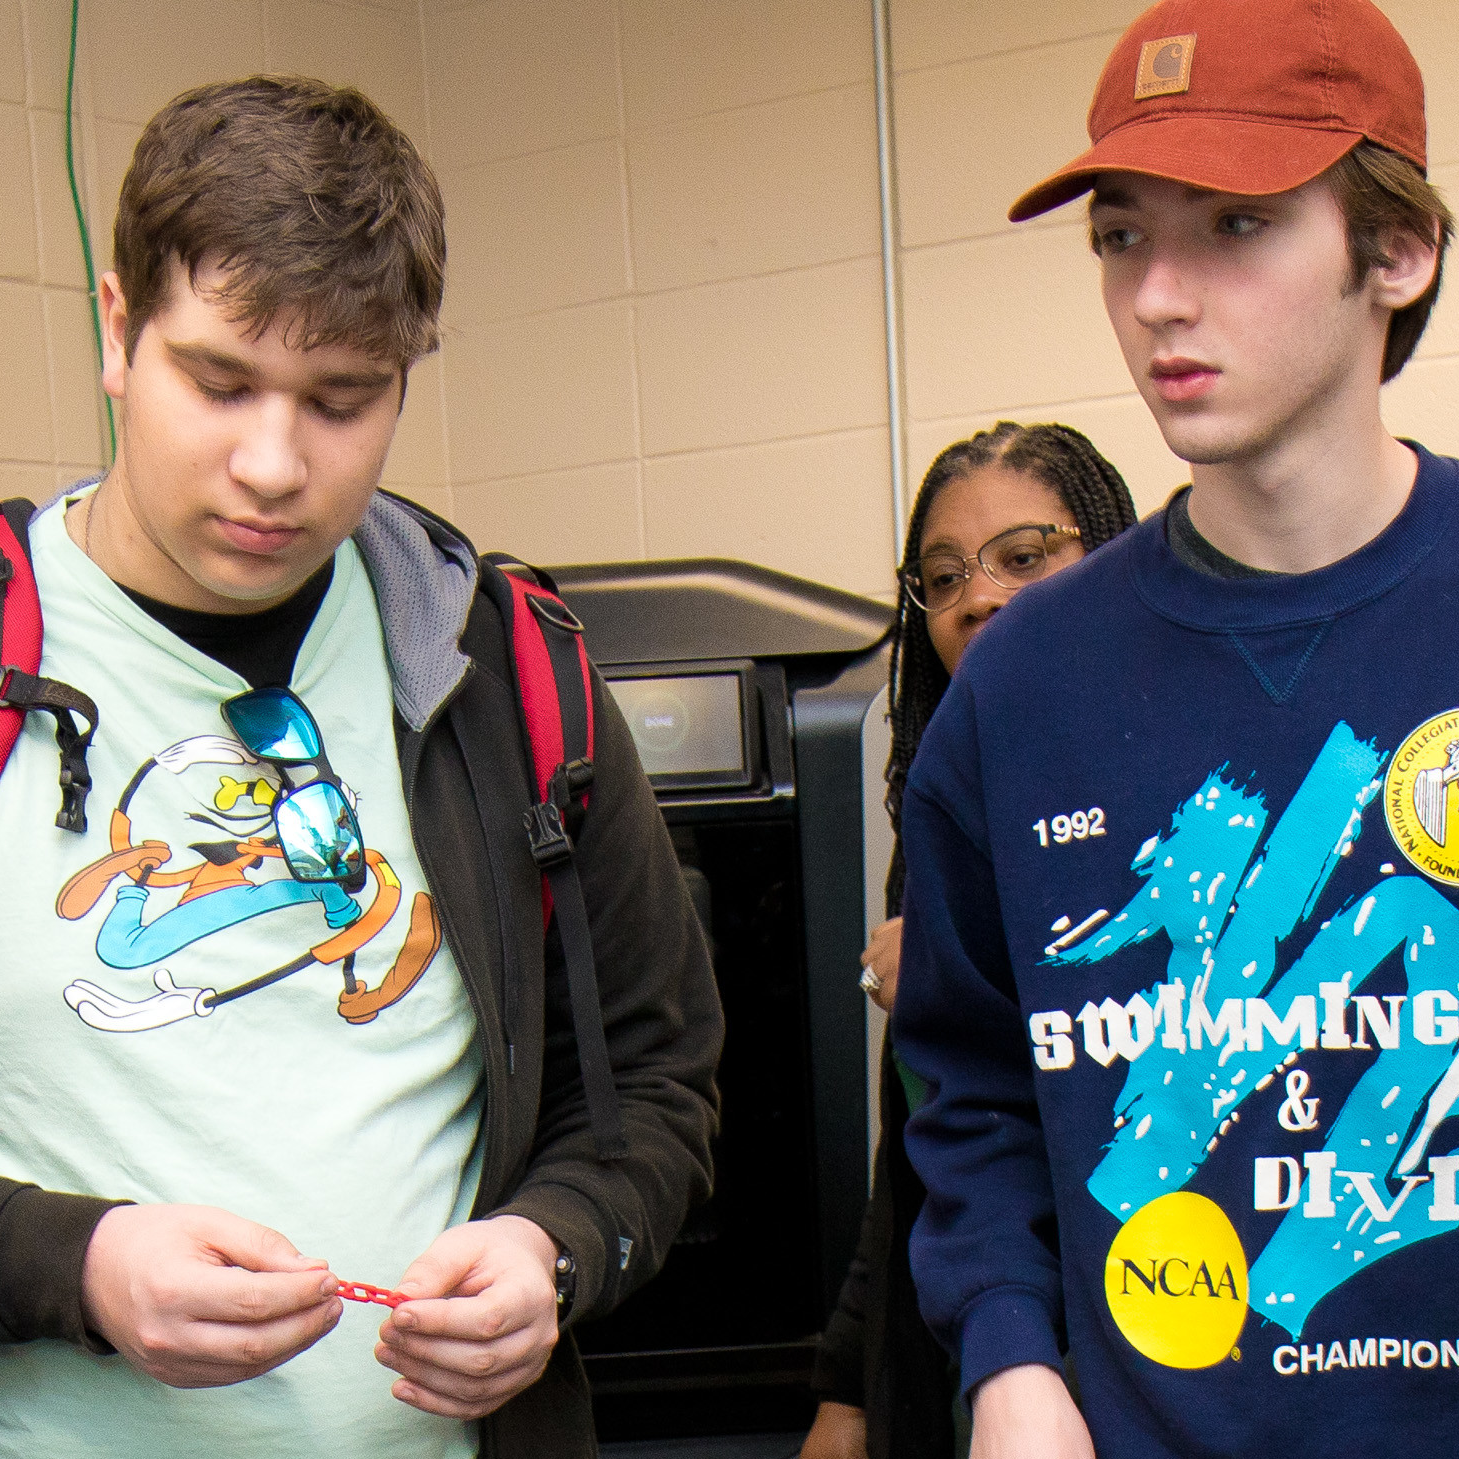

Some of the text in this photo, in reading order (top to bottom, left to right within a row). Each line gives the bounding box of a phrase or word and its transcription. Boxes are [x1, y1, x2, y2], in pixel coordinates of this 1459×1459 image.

[1032, 806, 1107, 848] 1992
[1392, 779, 1420, 854] NATIONAL
[1277, 1069, 1321, 1132] &
[1119, 1257, 1240, 1301] NCAA
